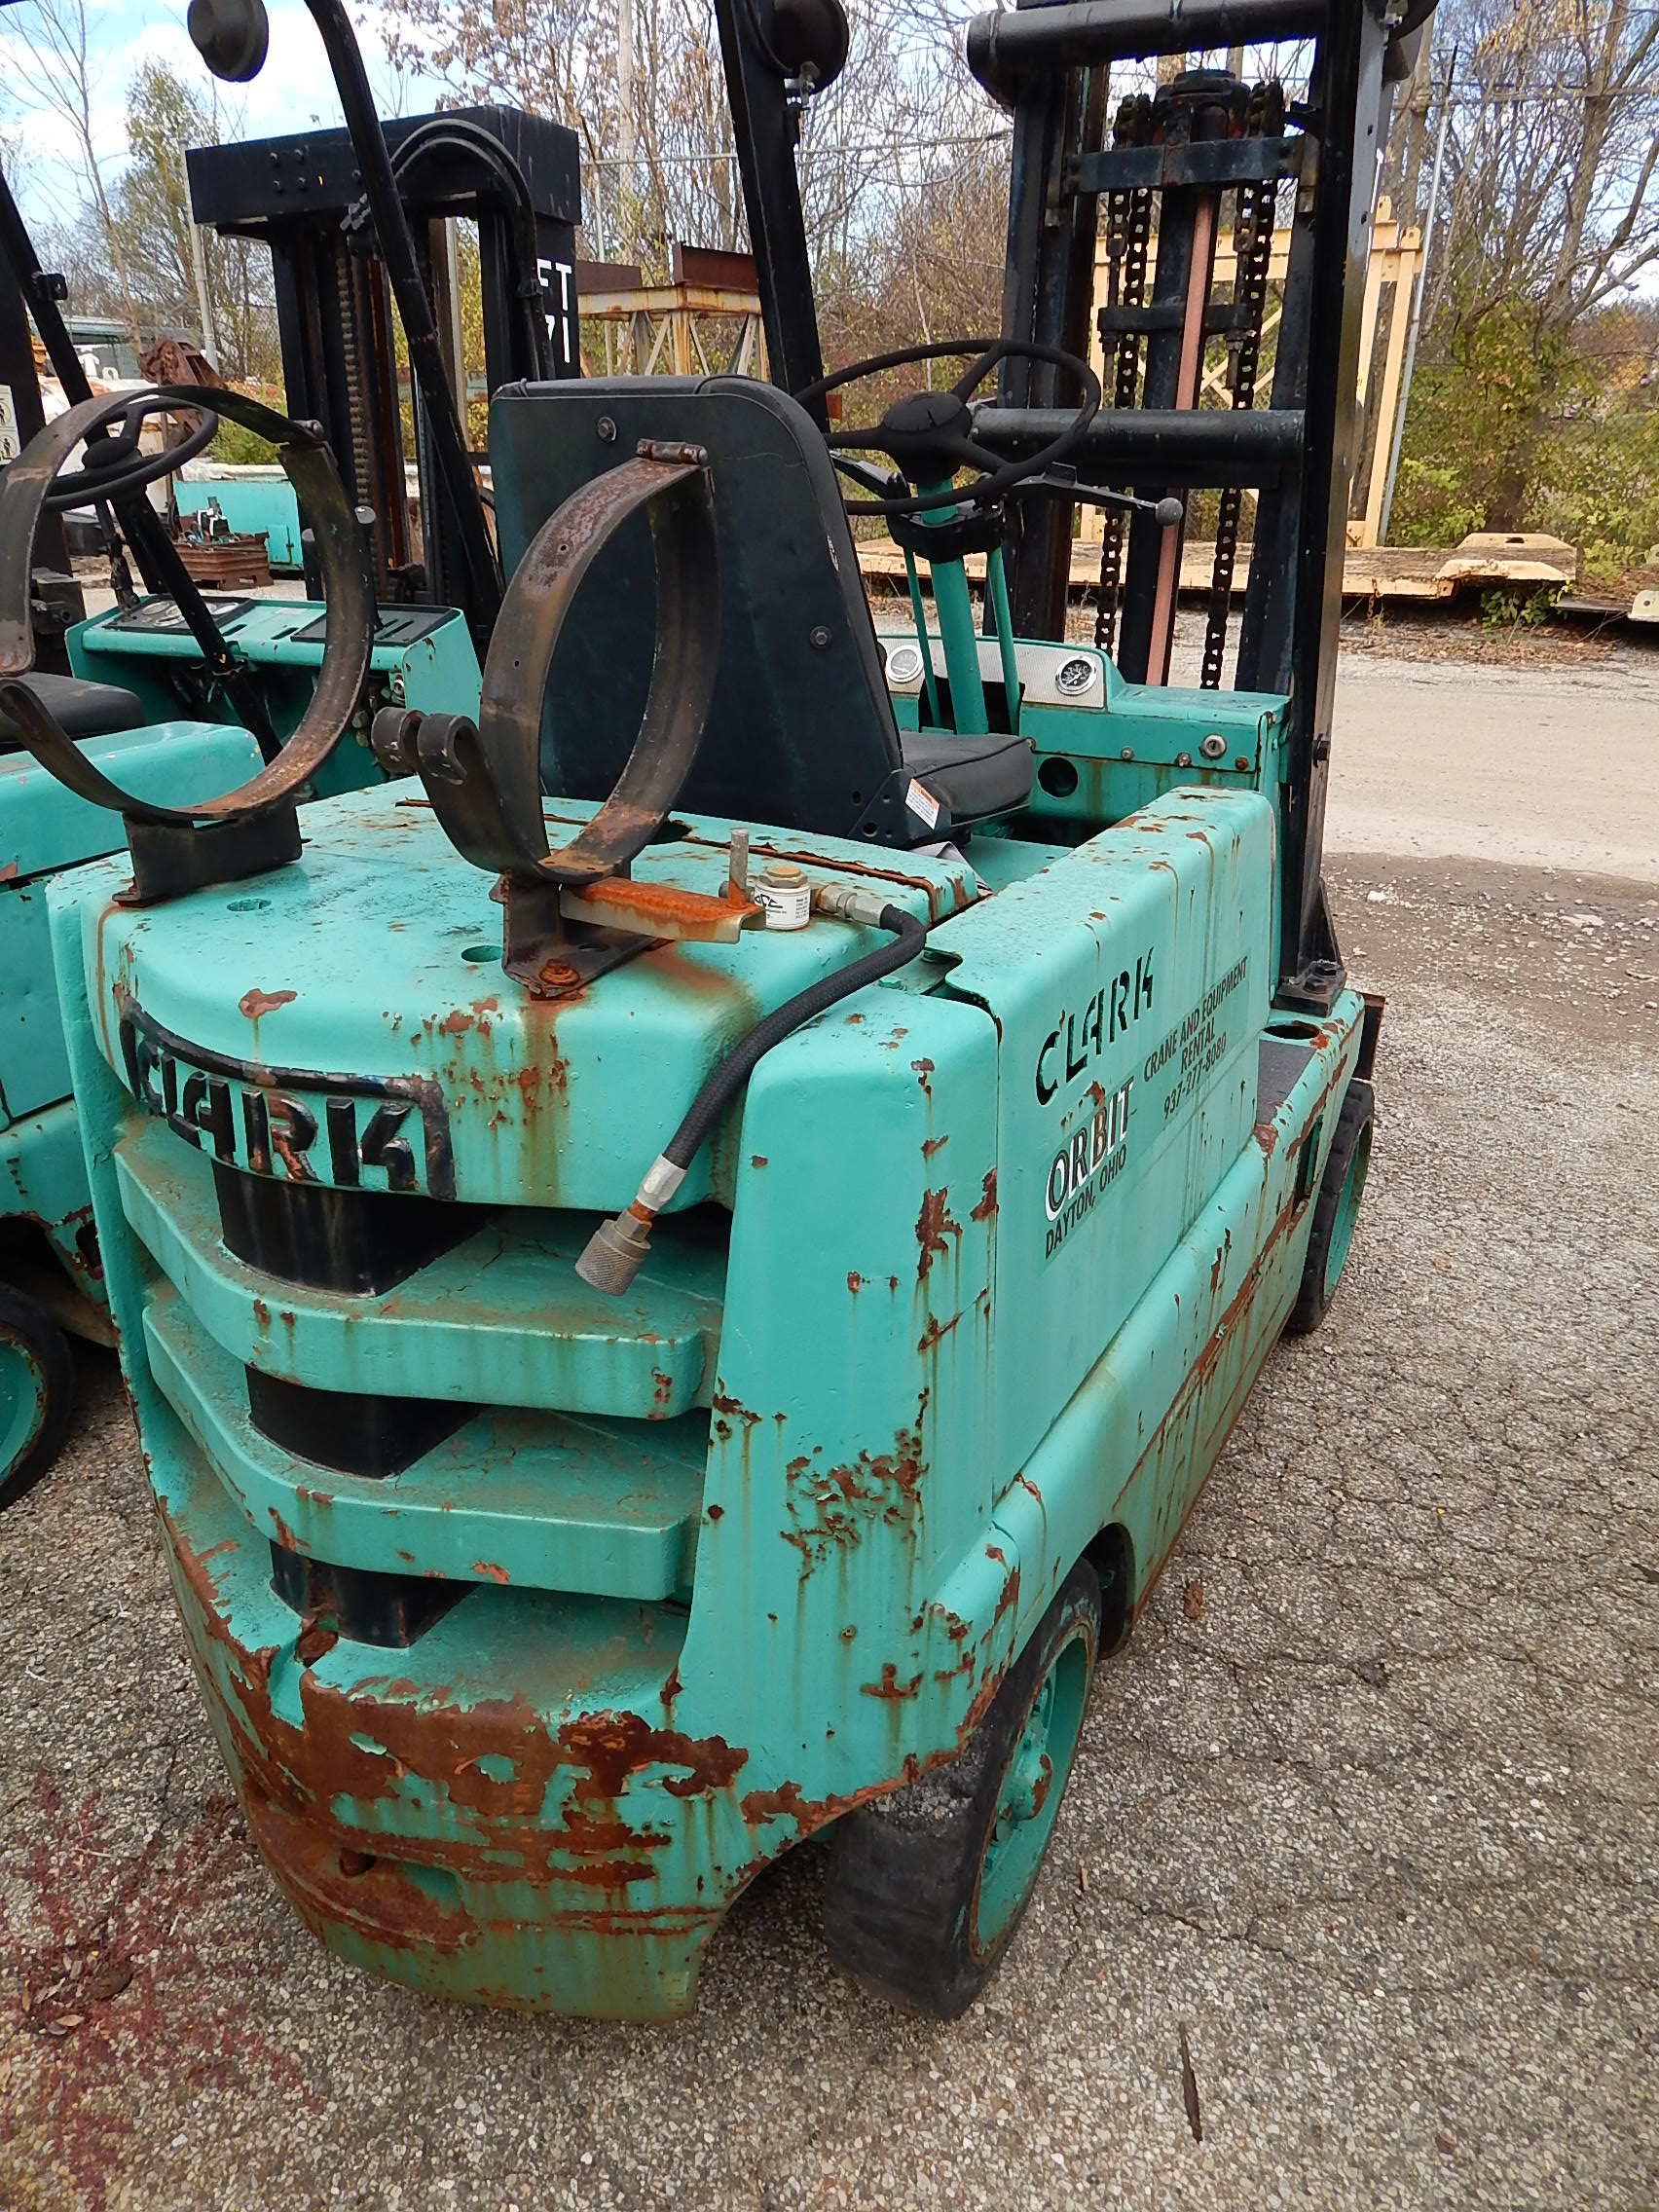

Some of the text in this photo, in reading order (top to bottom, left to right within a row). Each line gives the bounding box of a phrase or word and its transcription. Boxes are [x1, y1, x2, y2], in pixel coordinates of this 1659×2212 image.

[1036, 946, 1155, 1106] CLARK
[1144, 956, 1248, 1083] CRANE AND EQUIPMENT
[1163, 1030, 1227, 1120] 937-277-8080
[1181, 1016, 1216, 1075] RENTAL
[137, 1038, 416, 1192] CLARK
[1045, 1076, 1135, 1222] ORBIT
[1045, 1144, 1127, 1260] DAYTON, OHIO
